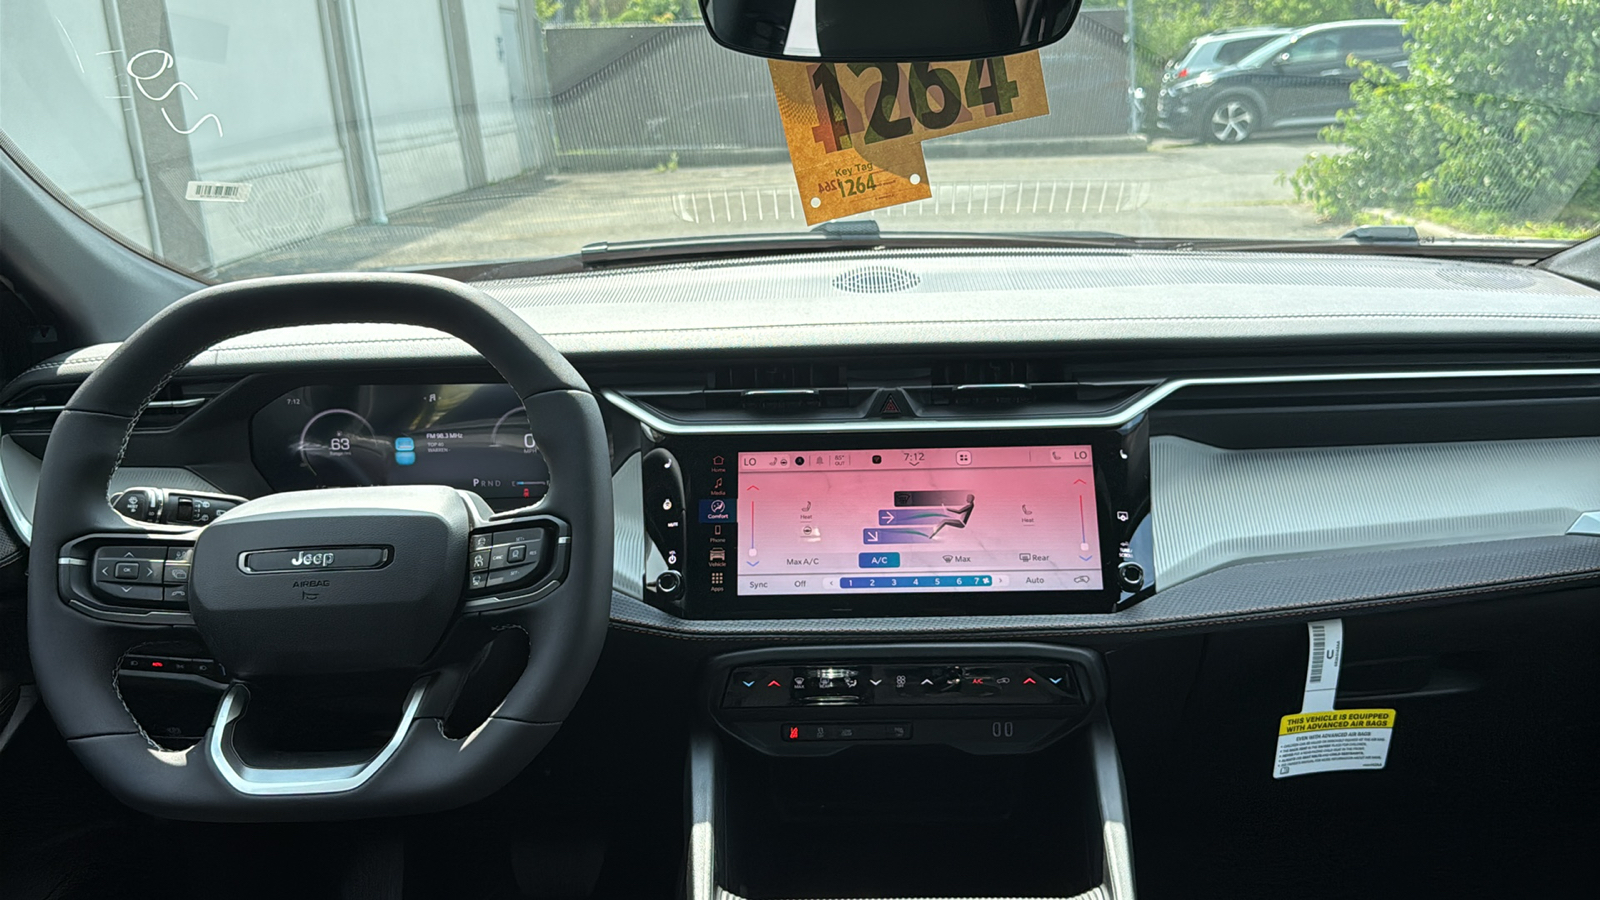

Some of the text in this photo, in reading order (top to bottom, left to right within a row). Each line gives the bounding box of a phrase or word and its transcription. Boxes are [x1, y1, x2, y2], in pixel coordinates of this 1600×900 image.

[812, 56, 1020, 151] 1264
[834, 162, 874, 177] Key Tag
[839, 173, 877, 198] 1264
[331, 437, 350, 451] 63
[903, 452, 925, 462] 7:12
[1074, 450, 1088, 460] LO
[743, 458, 757, 466] LO
[472, 478, 480, 487] P
[291, 551, 335, 567] Jeep
[786, 558, 820, 566] Max A/C
[871, 556, 888, 564] A/C
[954, 555, 972, 563] Max
[1032, 553, 1049, 562] Rear
[292, 579, 331, 588] AIRBAG
[794, 580, 807, 588] Off
[912, 578, 919, 586] 4
[934, 578, 940, 586] 5
[956, 577, 962, 585] 6
[974, 577, 980, 585] 7
[1025, 576, 1045, 584] Auto
[749, 581, 768, 589] Sync
[1287, 717, 1305, 726] THIS
[1305, 714, 1338, 723] VEHICLE
[1286, 725, 1306, 733] WITH
[1306, 721, 1349, 730] ADVANCED
